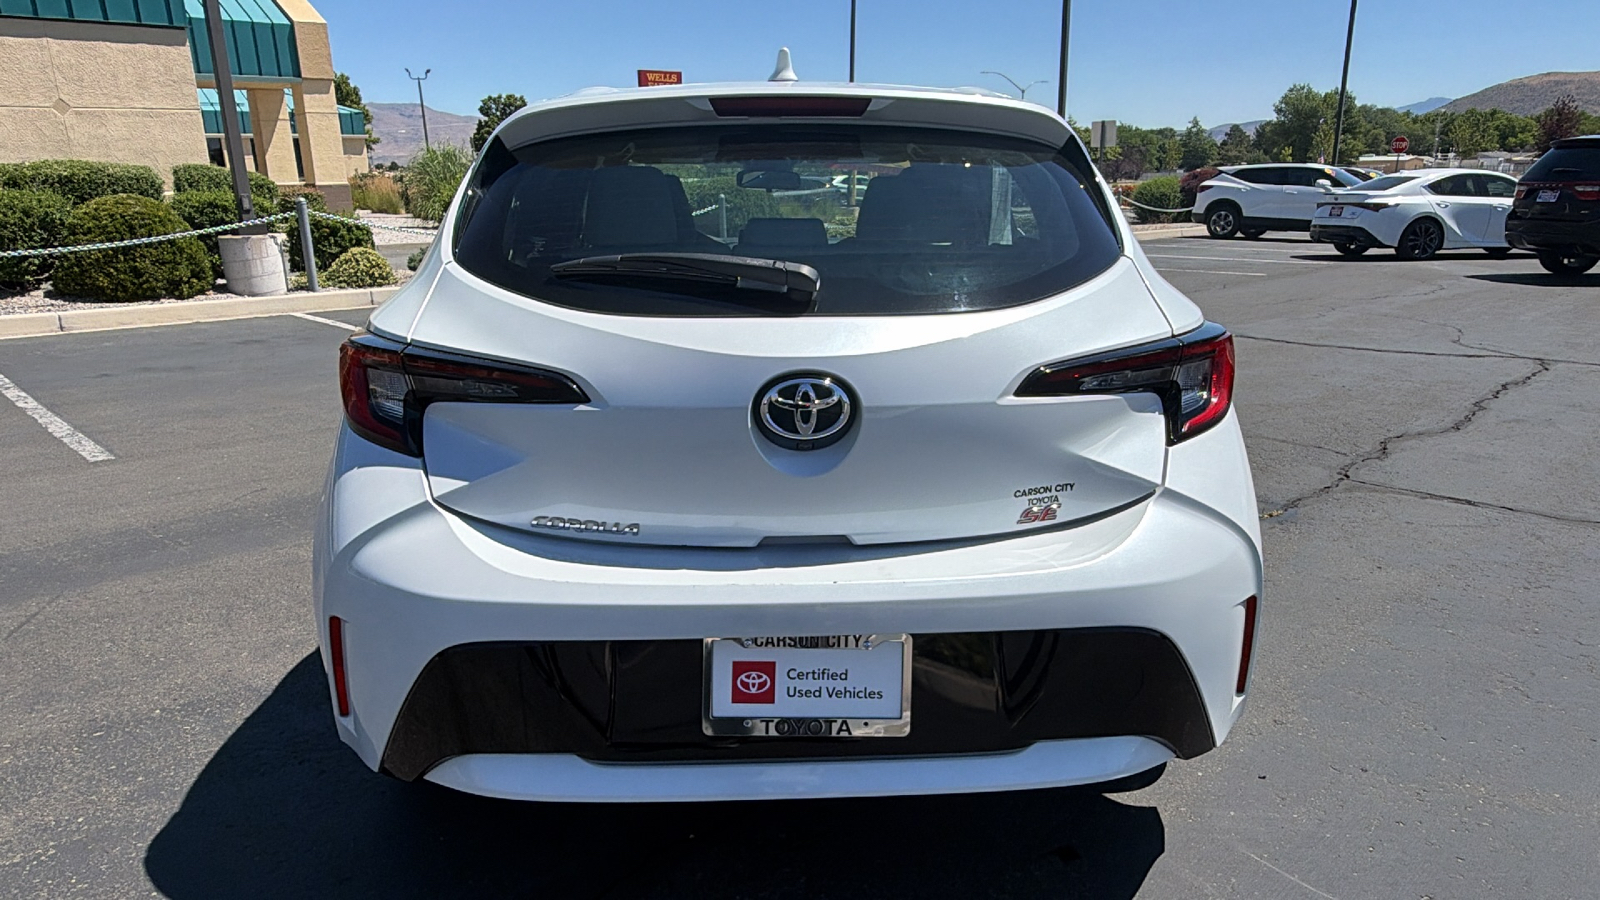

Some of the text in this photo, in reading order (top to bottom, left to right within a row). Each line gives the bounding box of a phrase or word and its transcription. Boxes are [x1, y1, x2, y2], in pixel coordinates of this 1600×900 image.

[646, 73, 677, 82] WELLS
[1392, 141, 1408, 149] STOP
[1014, 483, 1075, 498] CARSON CITY
[1027, 495, 1059, 506] TOYOTA
[1016, 503, 1061, 524] SE
[530, 516, 640, 536] COROLLA
[754, 635, 863, 648] CARSON CITY
[786, 668, 848, 681] Certified
[786, 687, 883, 699] Used Vehicles
[760, 719, 852, 735] TOYOTA
